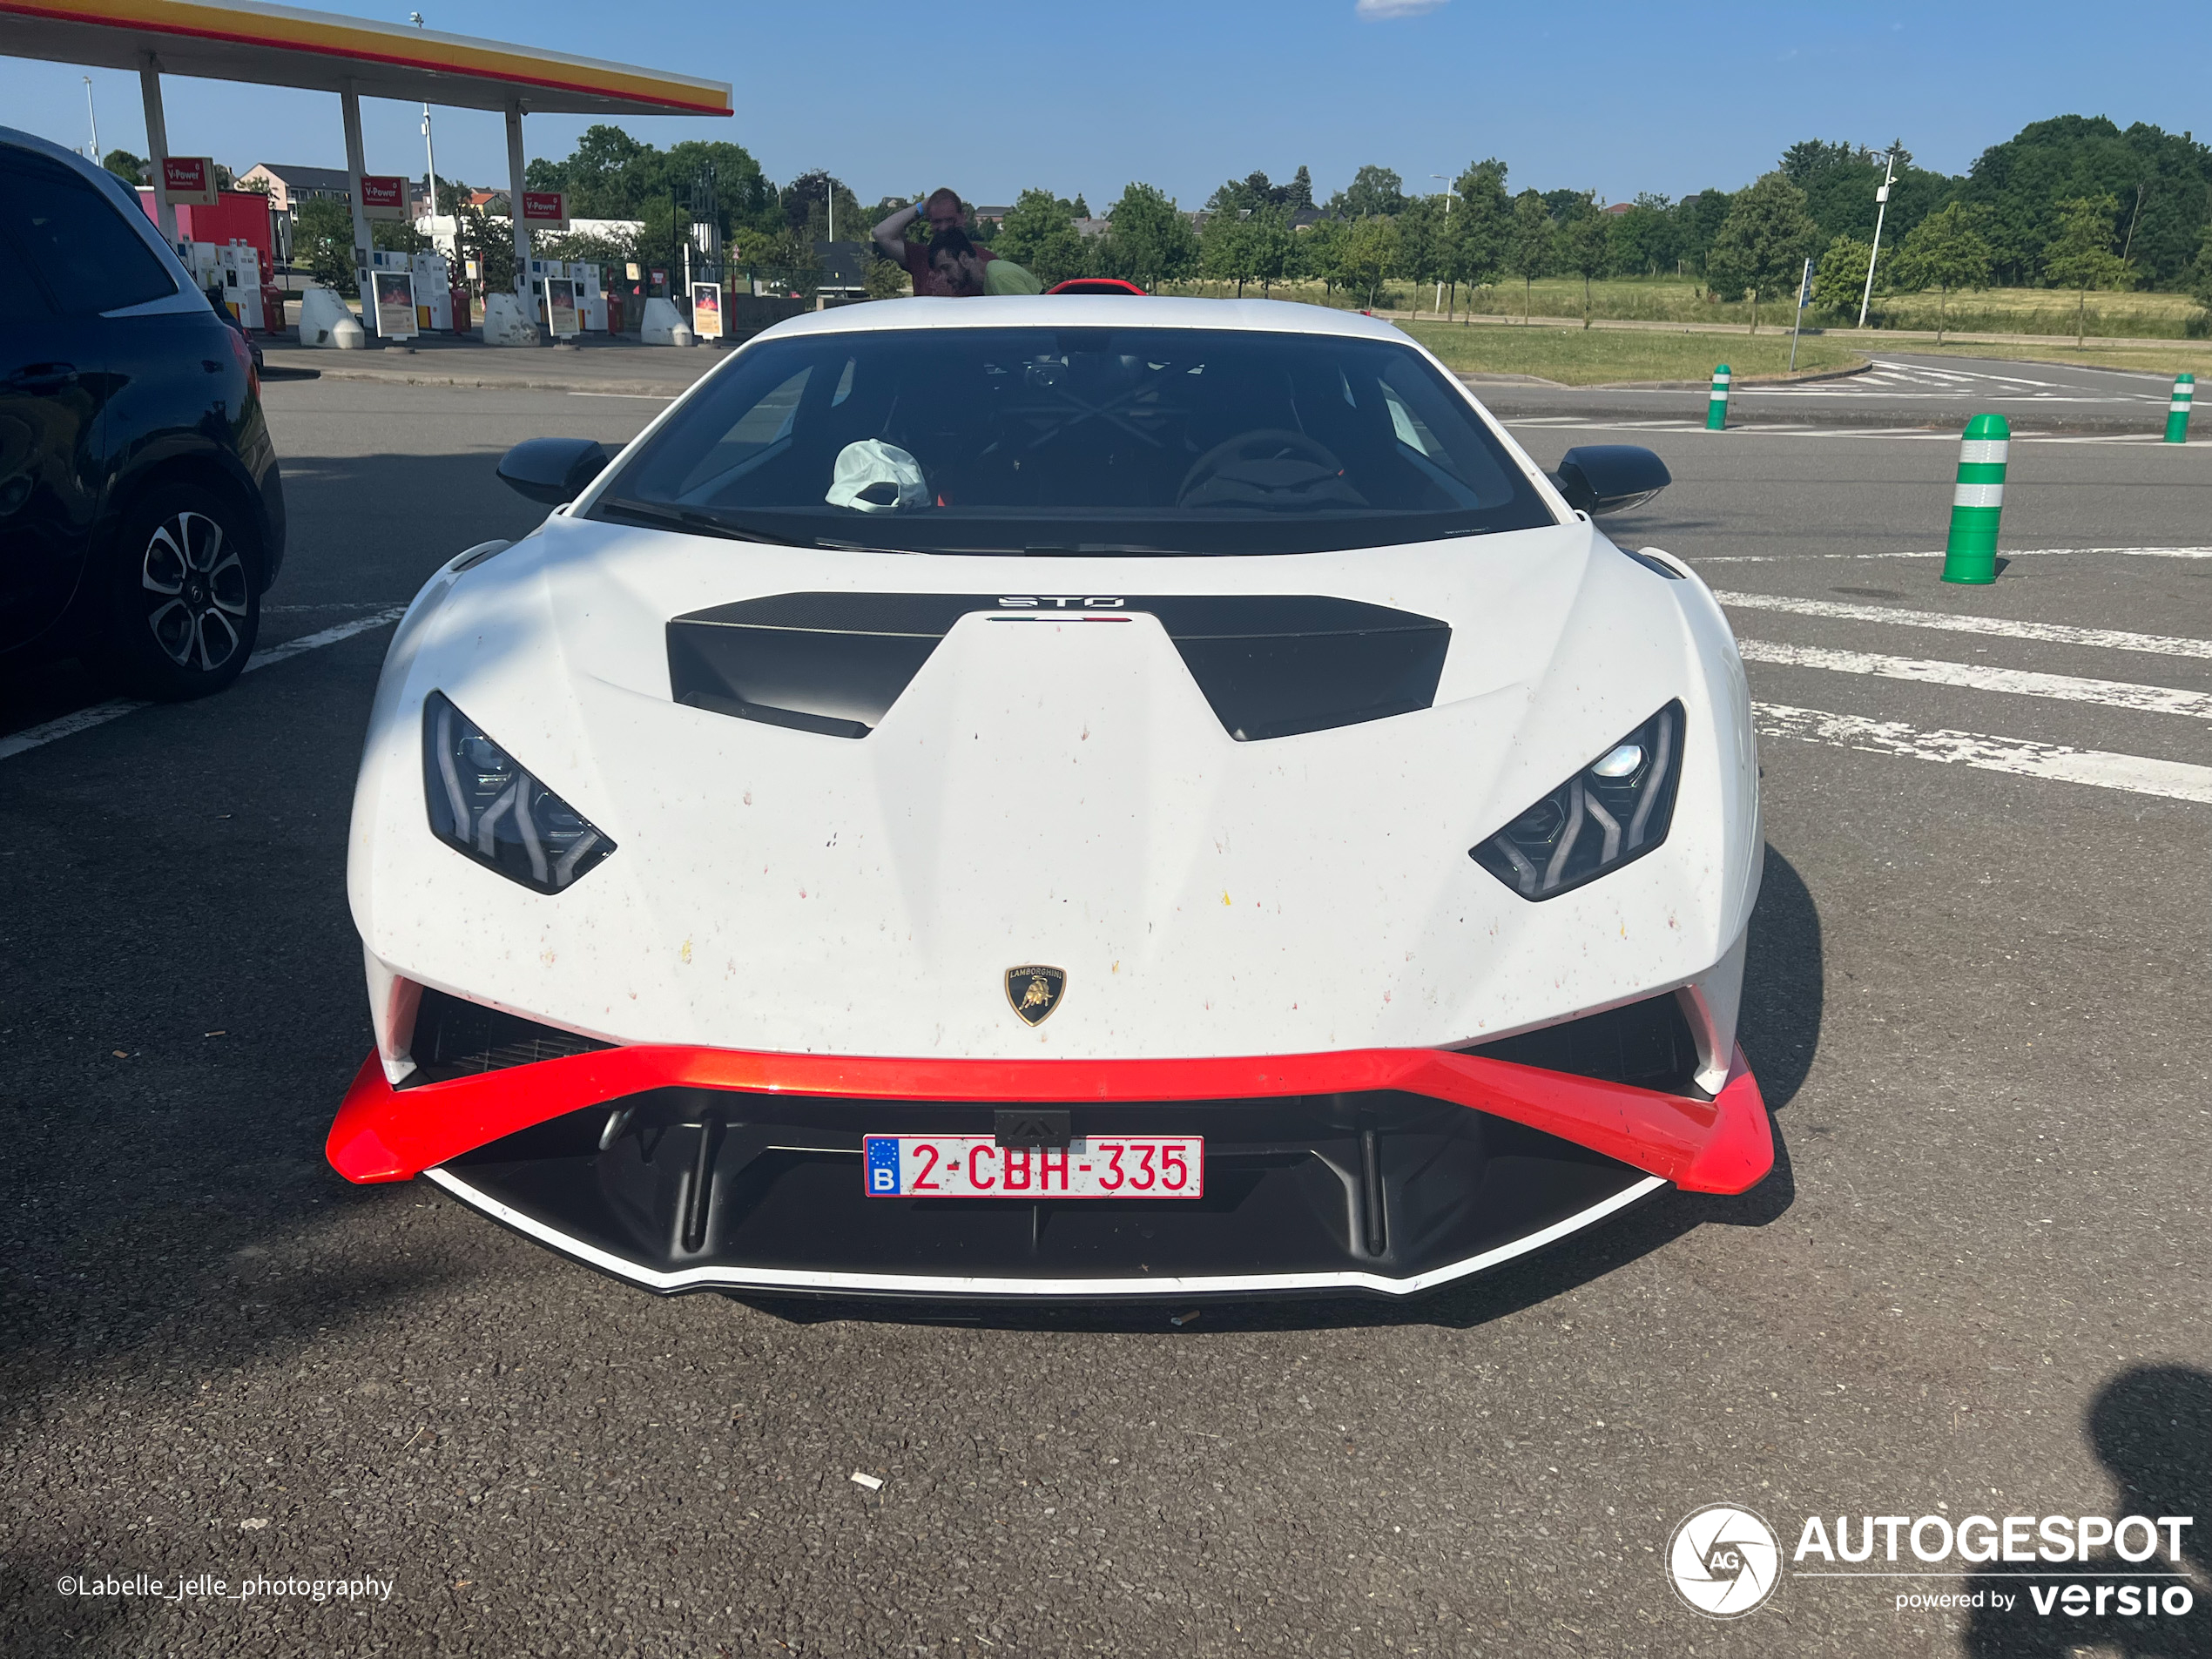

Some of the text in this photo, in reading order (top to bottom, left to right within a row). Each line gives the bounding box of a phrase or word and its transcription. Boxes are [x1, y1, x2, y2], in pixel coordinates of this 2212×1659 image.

[167, 168, 199, 180] V-Power
[365, 186, 396, 198] V-Power
[526, 201, 556, 212] V-Power
[998, 597, 1124, 608] STO
[1010, 968, 1062, 979] LAMBORGHINI
[913, 1143, 1188, 1190] 2-CBH-335
[873, 1168, 895, 1190] B
